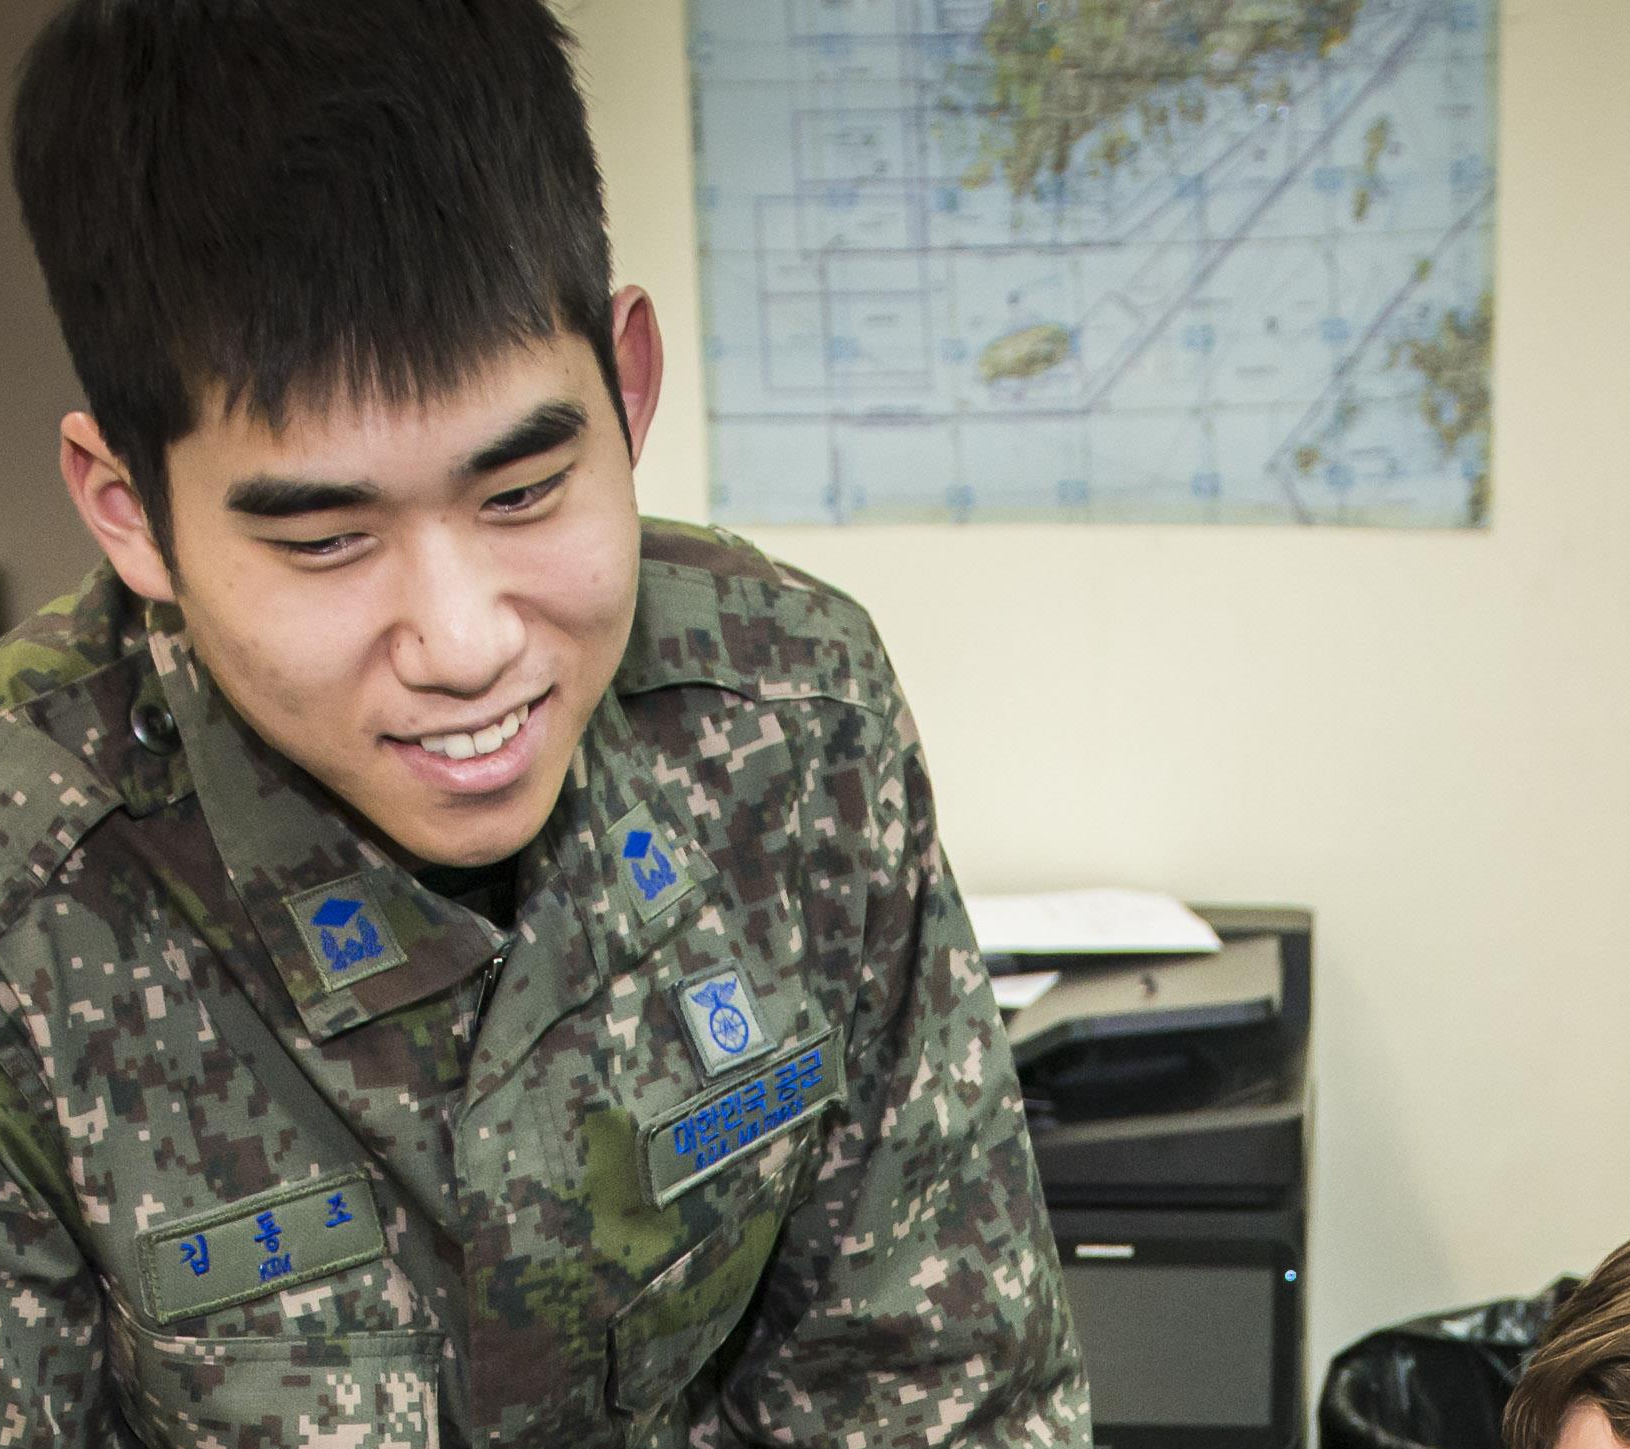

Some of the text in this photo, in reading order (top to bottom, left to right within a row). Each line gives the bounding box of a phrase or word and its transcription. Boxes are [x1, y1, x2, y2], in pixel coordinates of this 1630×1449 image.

[673, 1049, 823, 1157] 대한민국 공군
[179, 1233, 210, 1277] 김
